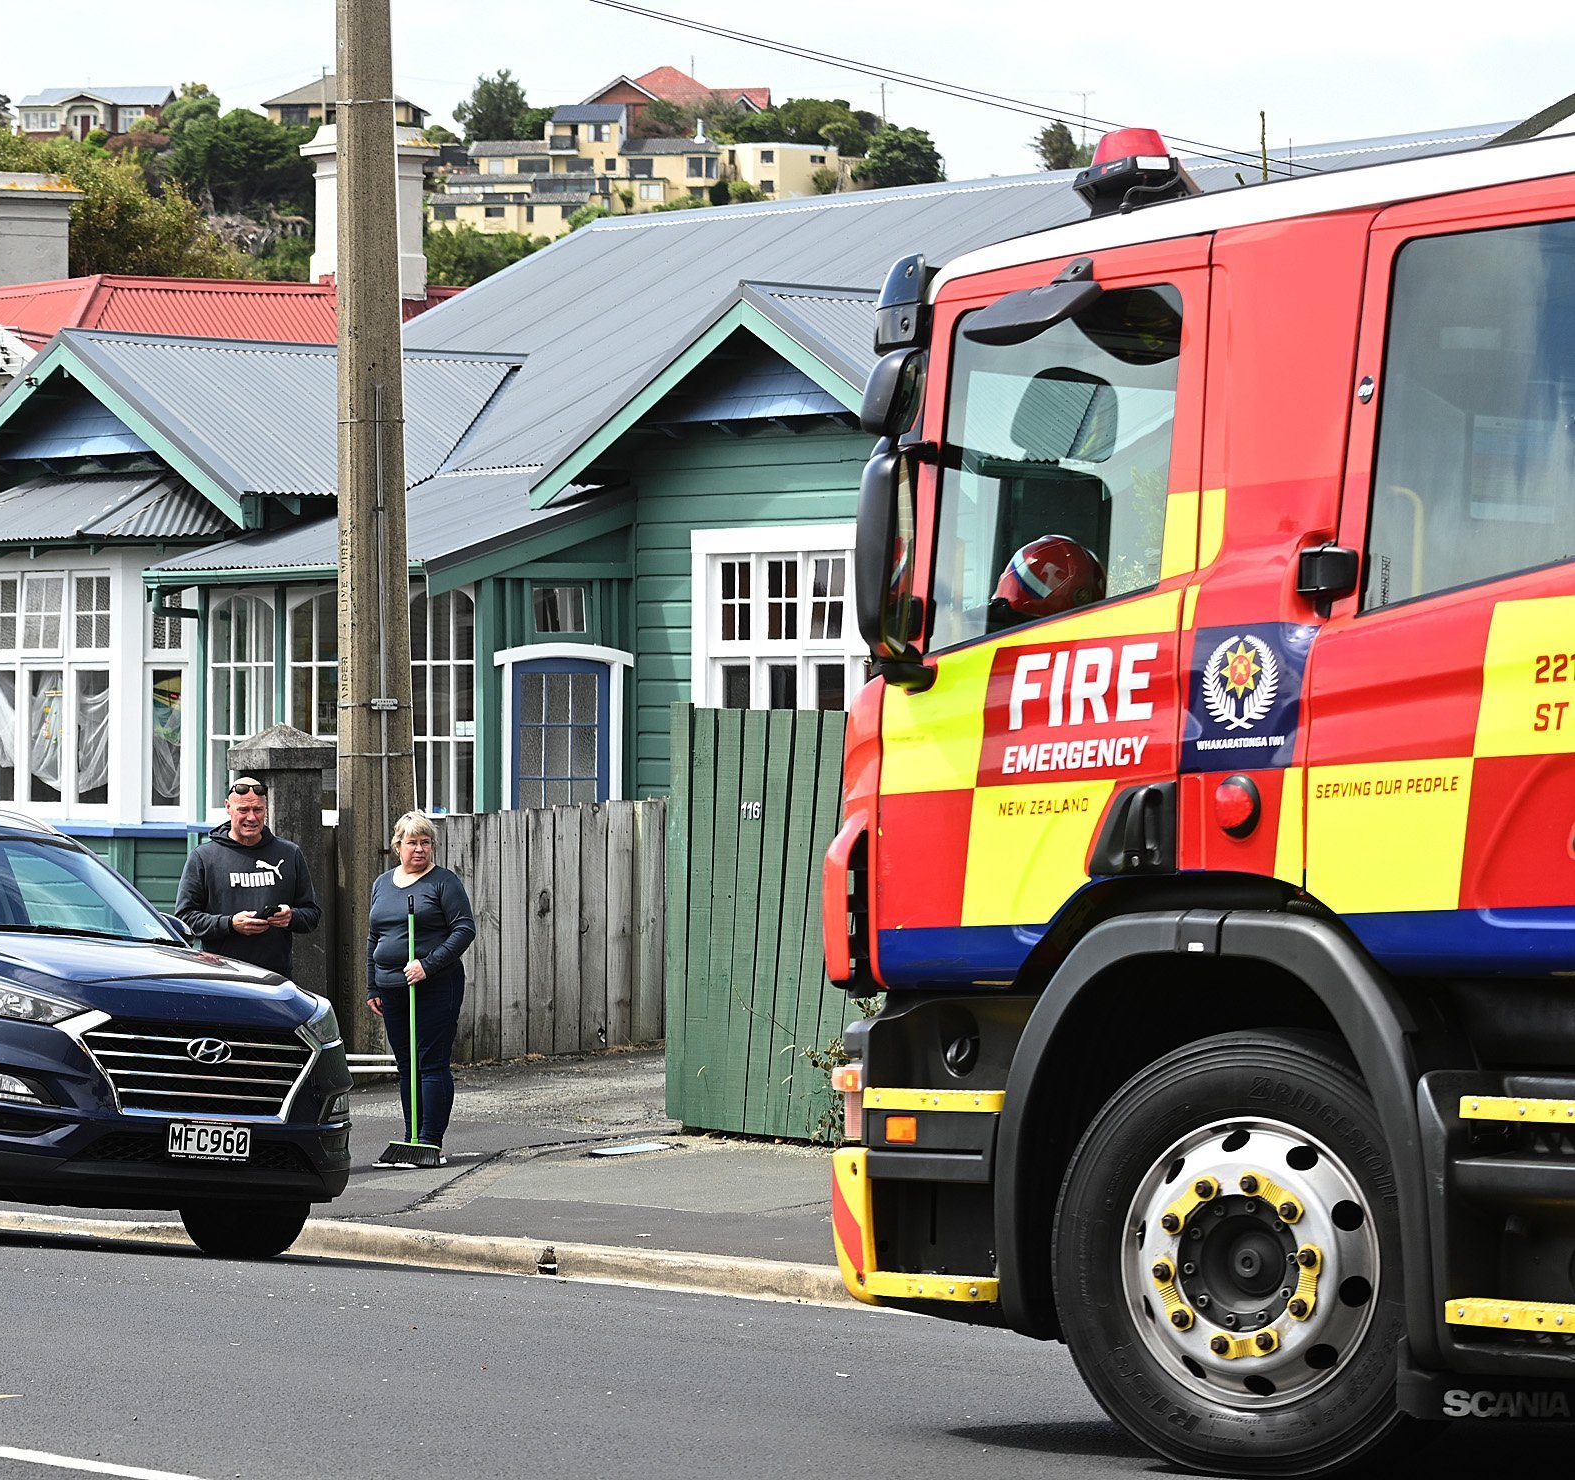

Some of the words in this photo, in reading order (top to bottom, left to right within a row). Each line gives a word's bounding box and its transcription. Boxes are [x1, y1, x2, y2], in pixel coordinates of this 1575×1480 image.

[341, 529, 349, 573] WIRES
[341, 581, 349, 612] LIVE
[1008, 642, 1159, 731] FIRE
[1533, 701, 1570, 732] ST
[1001, 736, 1149, 775] EMERGENCY
[1196, 736, 1267, 751] WHAKARATONGA
[1268, 736, 1285, 747] IWI
[1315, 781, 1372, 799] SERVING
[1375, 779, 1403, 796] OUR
[1406, 776, 1459, 794] PEOPLE
[741, 801, 761, 820] 116
[998, 801, 1026, 817] NEW
[1029, 797, 1089, 815] ZEALAND
[229, 871, 276, 888] PUMA
[170, 1126, 248, 1154] MFC960
[1442, 1389, 1571, 1418] SCANIA
